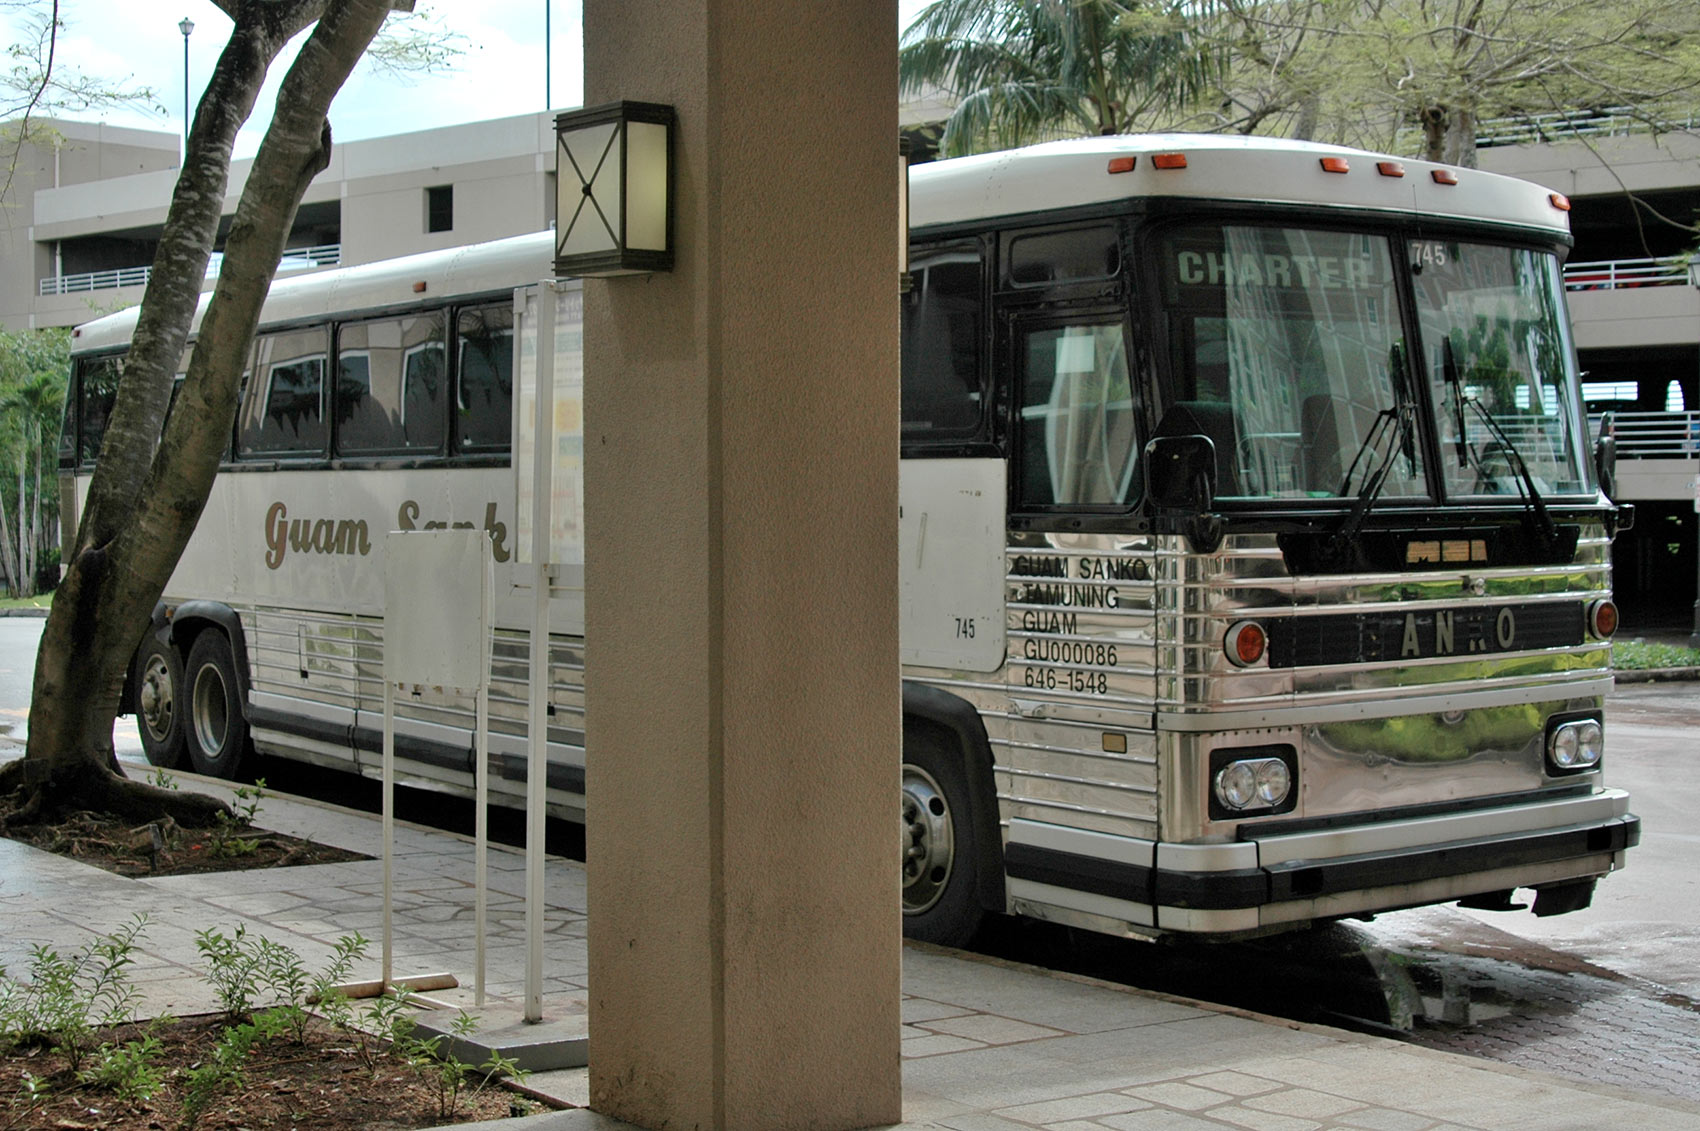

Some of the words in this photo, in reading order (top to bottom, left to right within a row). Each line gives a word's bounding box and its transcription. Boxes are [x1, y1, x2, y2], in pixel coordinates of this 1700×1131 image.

[1411, 243, 1447, 267] 745
[1178, 250, 1371, 290] CHARTER
[265, 501, 371, 569] Guam
[398, 500, 511, 563] Sk
[1015, 555, 1068, 577] GUAM
[1079, 557, 1148, 581] SANKO
[1022, 584, 1120, 609] TAMUNING
[954, 618, 976, 639] 745
[1023, 611, 1077, 634] GUAM
[1024, 639, 1118, 667] GU000086
[1024, 667, 1108, 694] 646-1548
